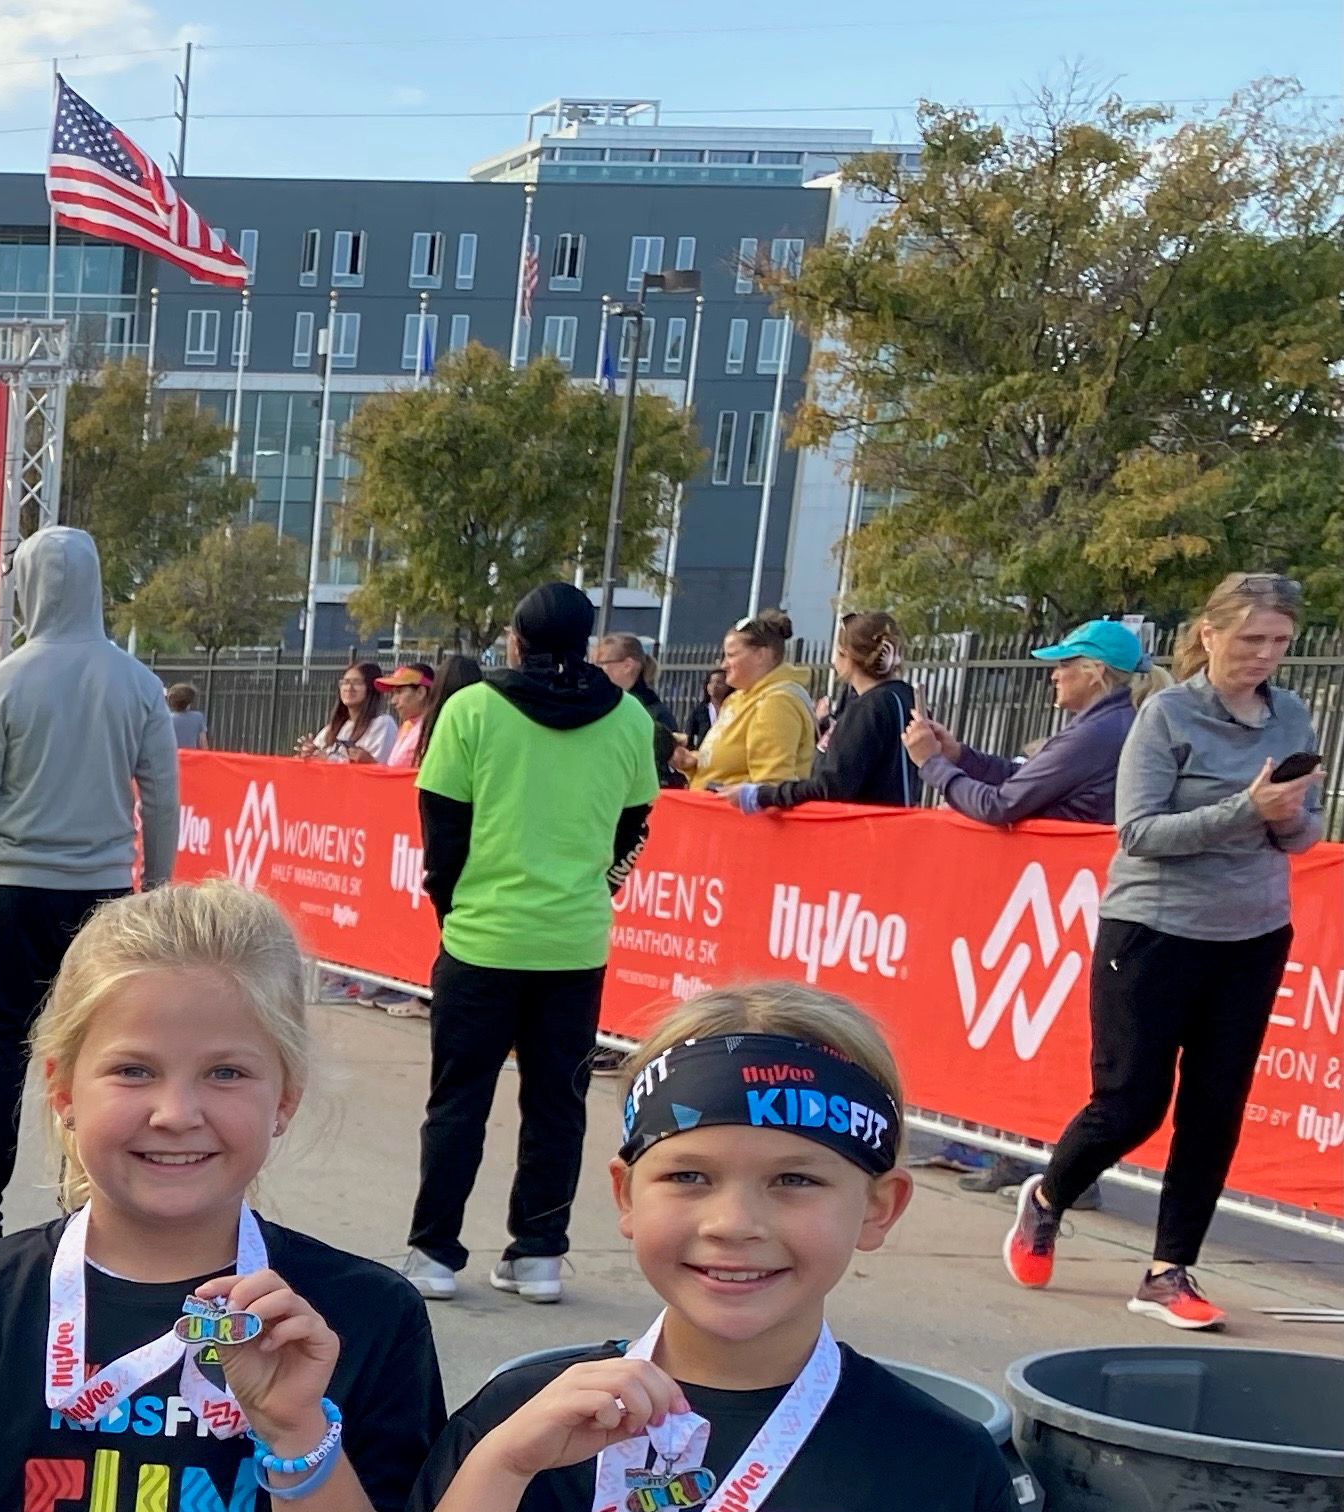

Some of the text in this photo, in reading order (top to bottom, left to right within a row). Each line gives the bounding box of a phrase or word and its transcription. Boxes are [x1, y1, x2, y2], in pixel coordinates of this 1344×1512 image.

[178, 805, 210, 855] Vee
[283, 820, 366, 868] WOMEN'S
[271, 863, 292, 884] HALF
[611, 869, 724, 927] OMEN'S
[698, 940, 720, 965] 5K
[768, 883, 908, 983] HyVee
[741, 1064, 815, 1086] HyVee
[746, 1088, 888, 1150] KIDSFIT
[51, 1321, 79, 1387] HyVee
